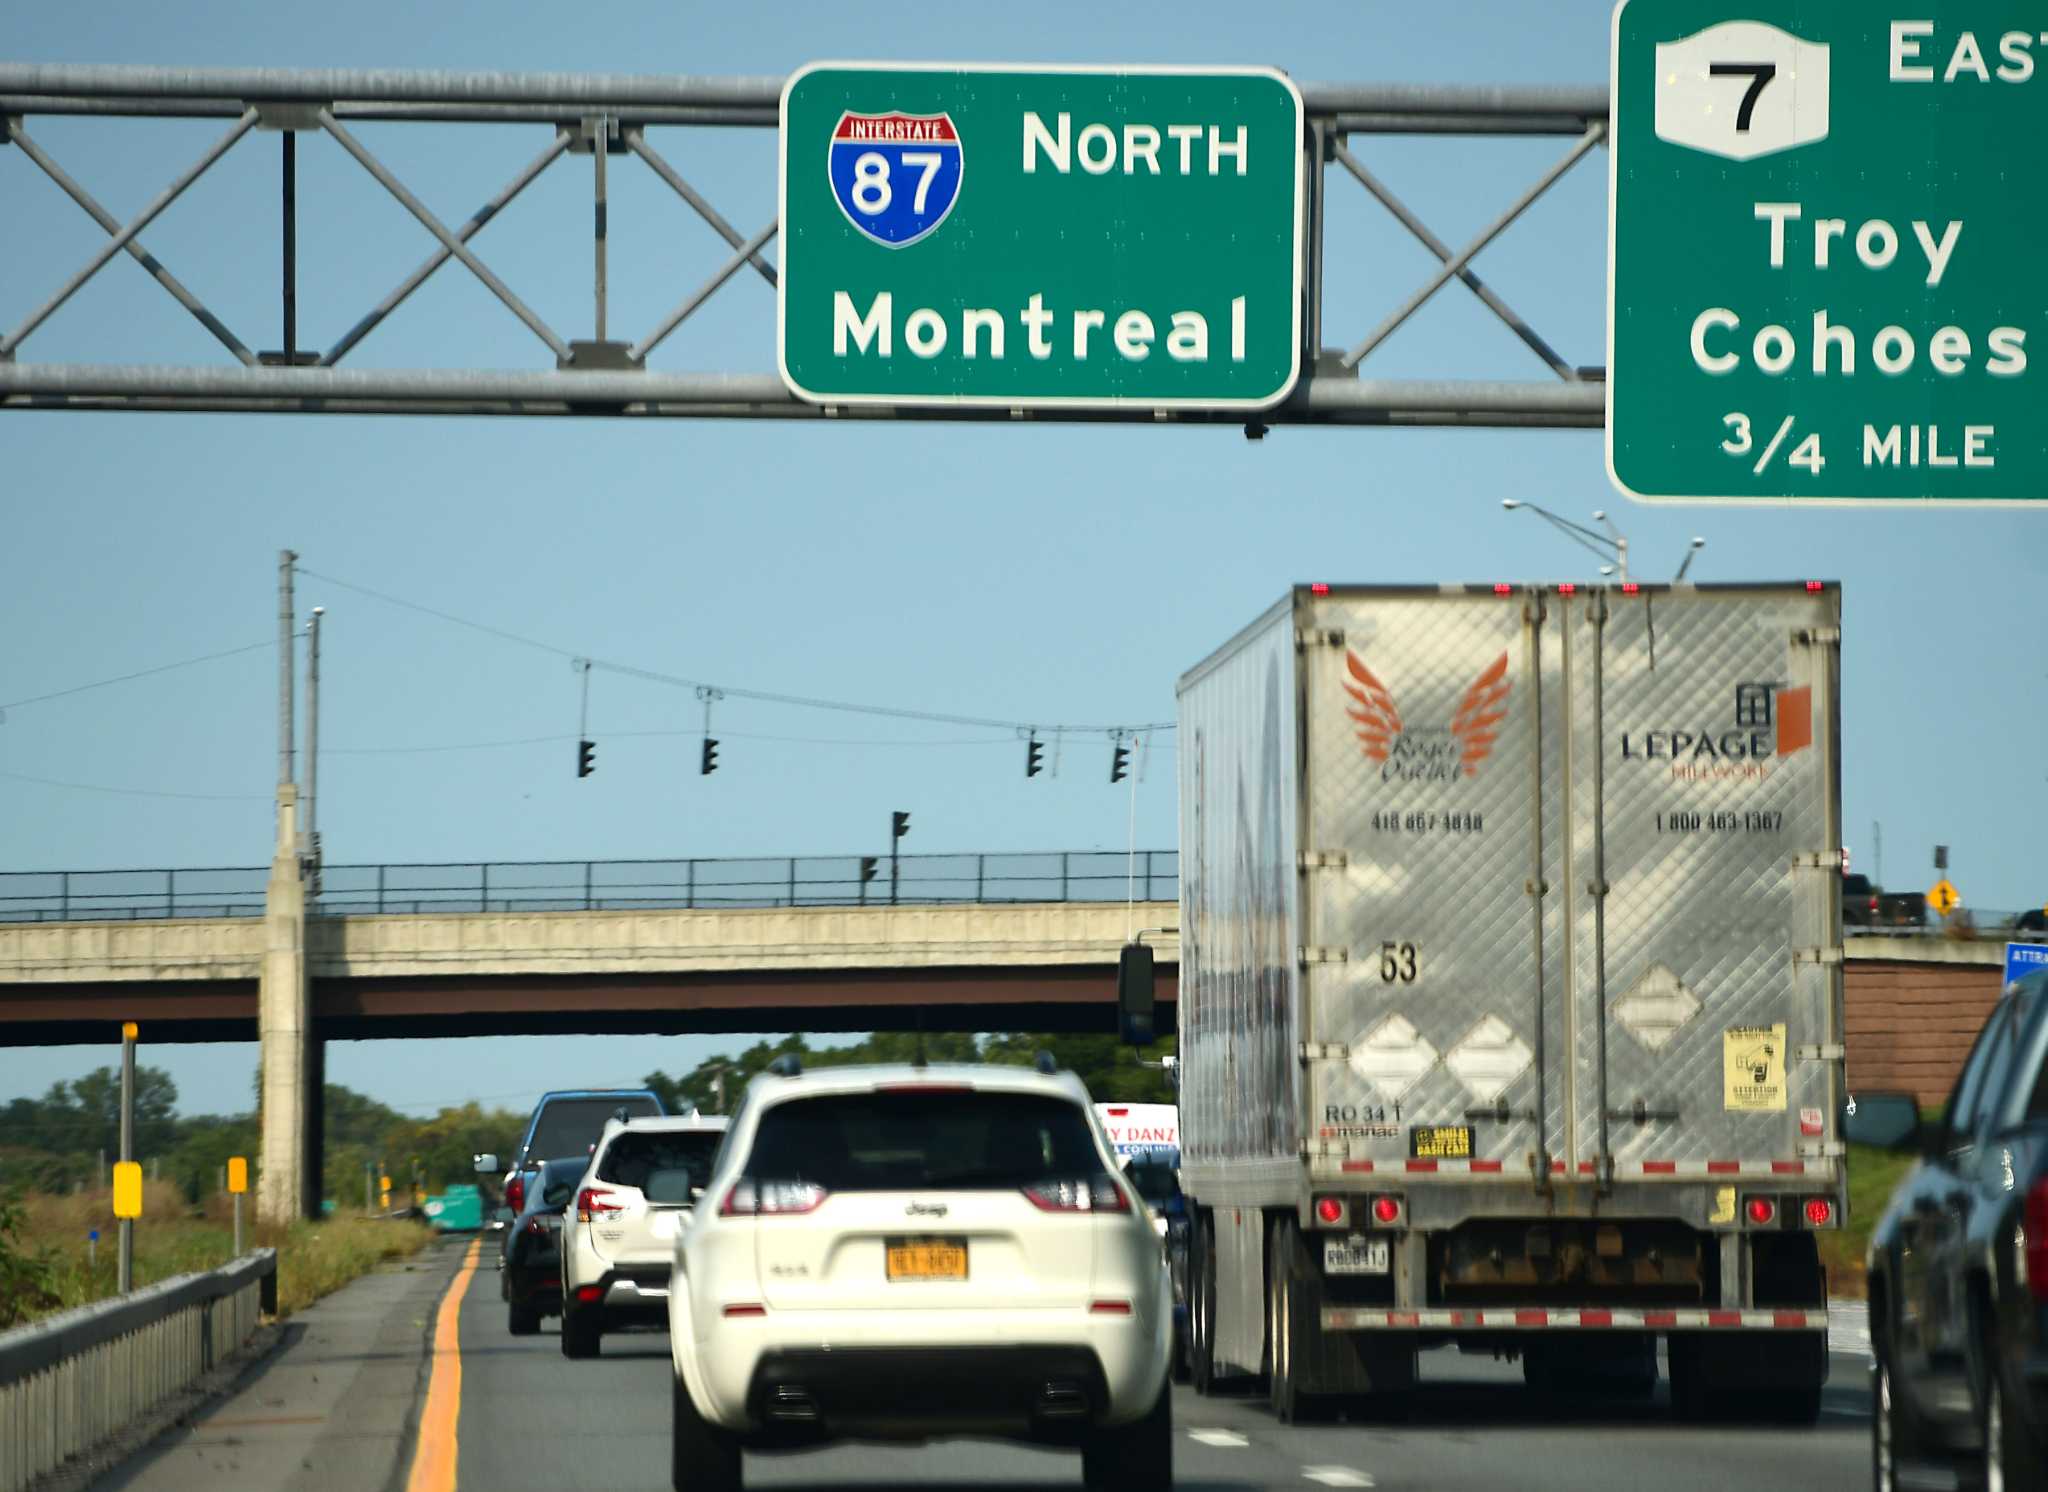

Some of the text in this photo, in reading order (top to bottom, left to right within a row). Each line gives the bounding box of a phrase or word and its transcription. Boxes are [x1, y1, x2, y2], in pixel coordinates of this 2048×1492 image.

[1889, 19, 2048, 84] EAS
[1708, 61, 1776, 134] 7
[849, 119, 943, 142] INTERSTATE
[1022, 111, 1248, 176] NORTH
[850, 152, 943, 216] 87
[1753, 202, 1964, 288] Troy
[832, 290, 1247, 363] Montreal
[1690, 306, 2028, 377] Cohoes
[1721, 411, 1996, 475] 3/4 MILE
[1622, 730, 1773, 761] LEPAGE
[1669, 811, 1701, 833] 800
[1381, 941, 1416, 984] 53
[1325, 1104, 1357, 1123] RO
